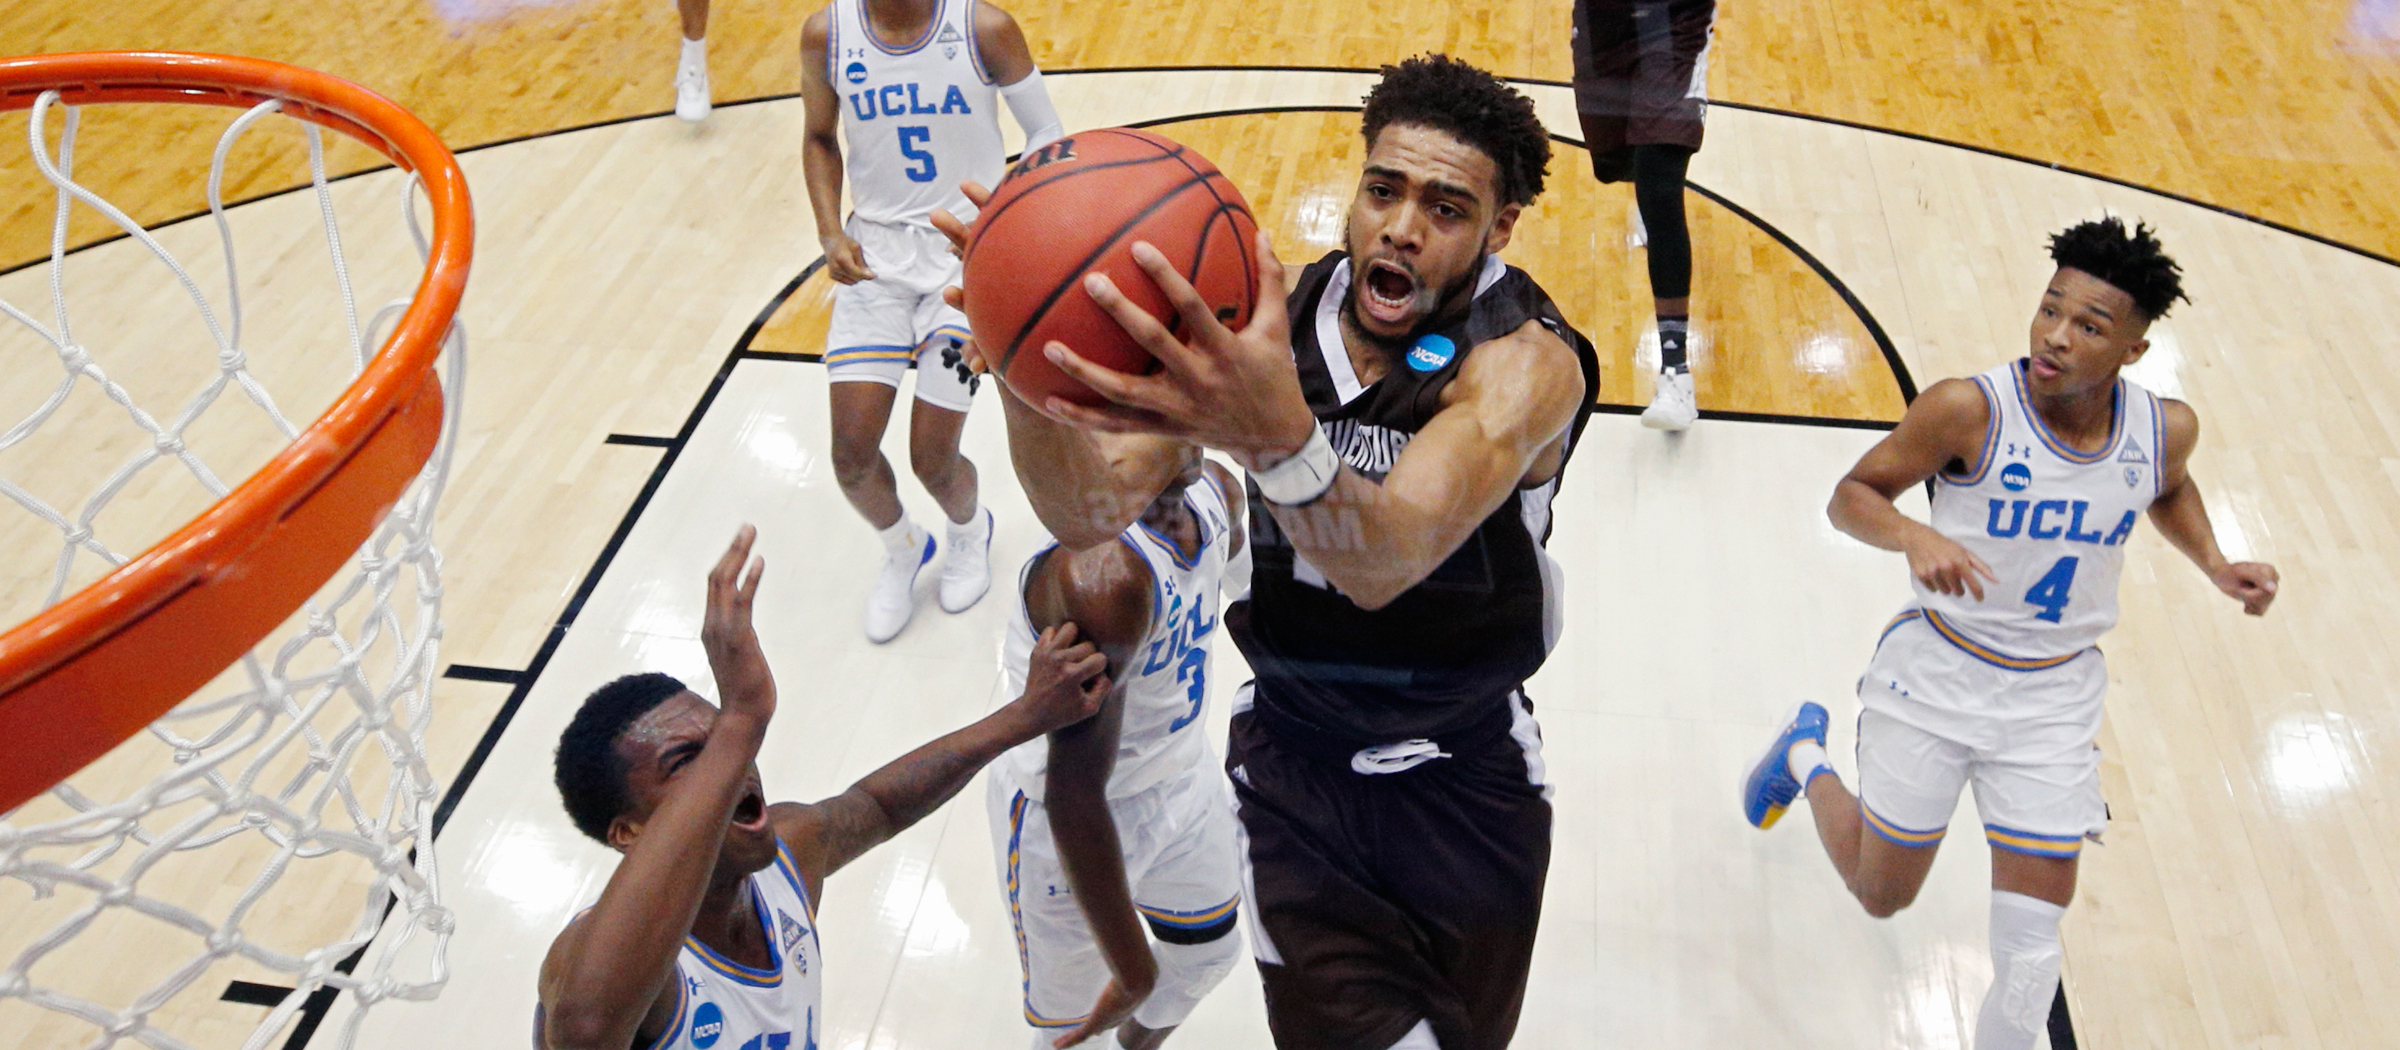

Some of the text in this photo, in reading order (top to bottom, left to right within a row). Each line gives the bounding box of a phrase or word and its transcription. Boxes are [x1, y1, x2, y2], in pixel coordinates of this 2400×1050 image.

[849, 83, 971, 120] UCLA
[897, 126, 937, 182] 5
[1410, 346, 1446, 367] NCAA
[1986, 498, 2136, 546] UCLA
[2024, 556, 2079, 624] 4
[1169, 647, 1207, 733] 3
[694, 1022, 721, 1040] NCAA
